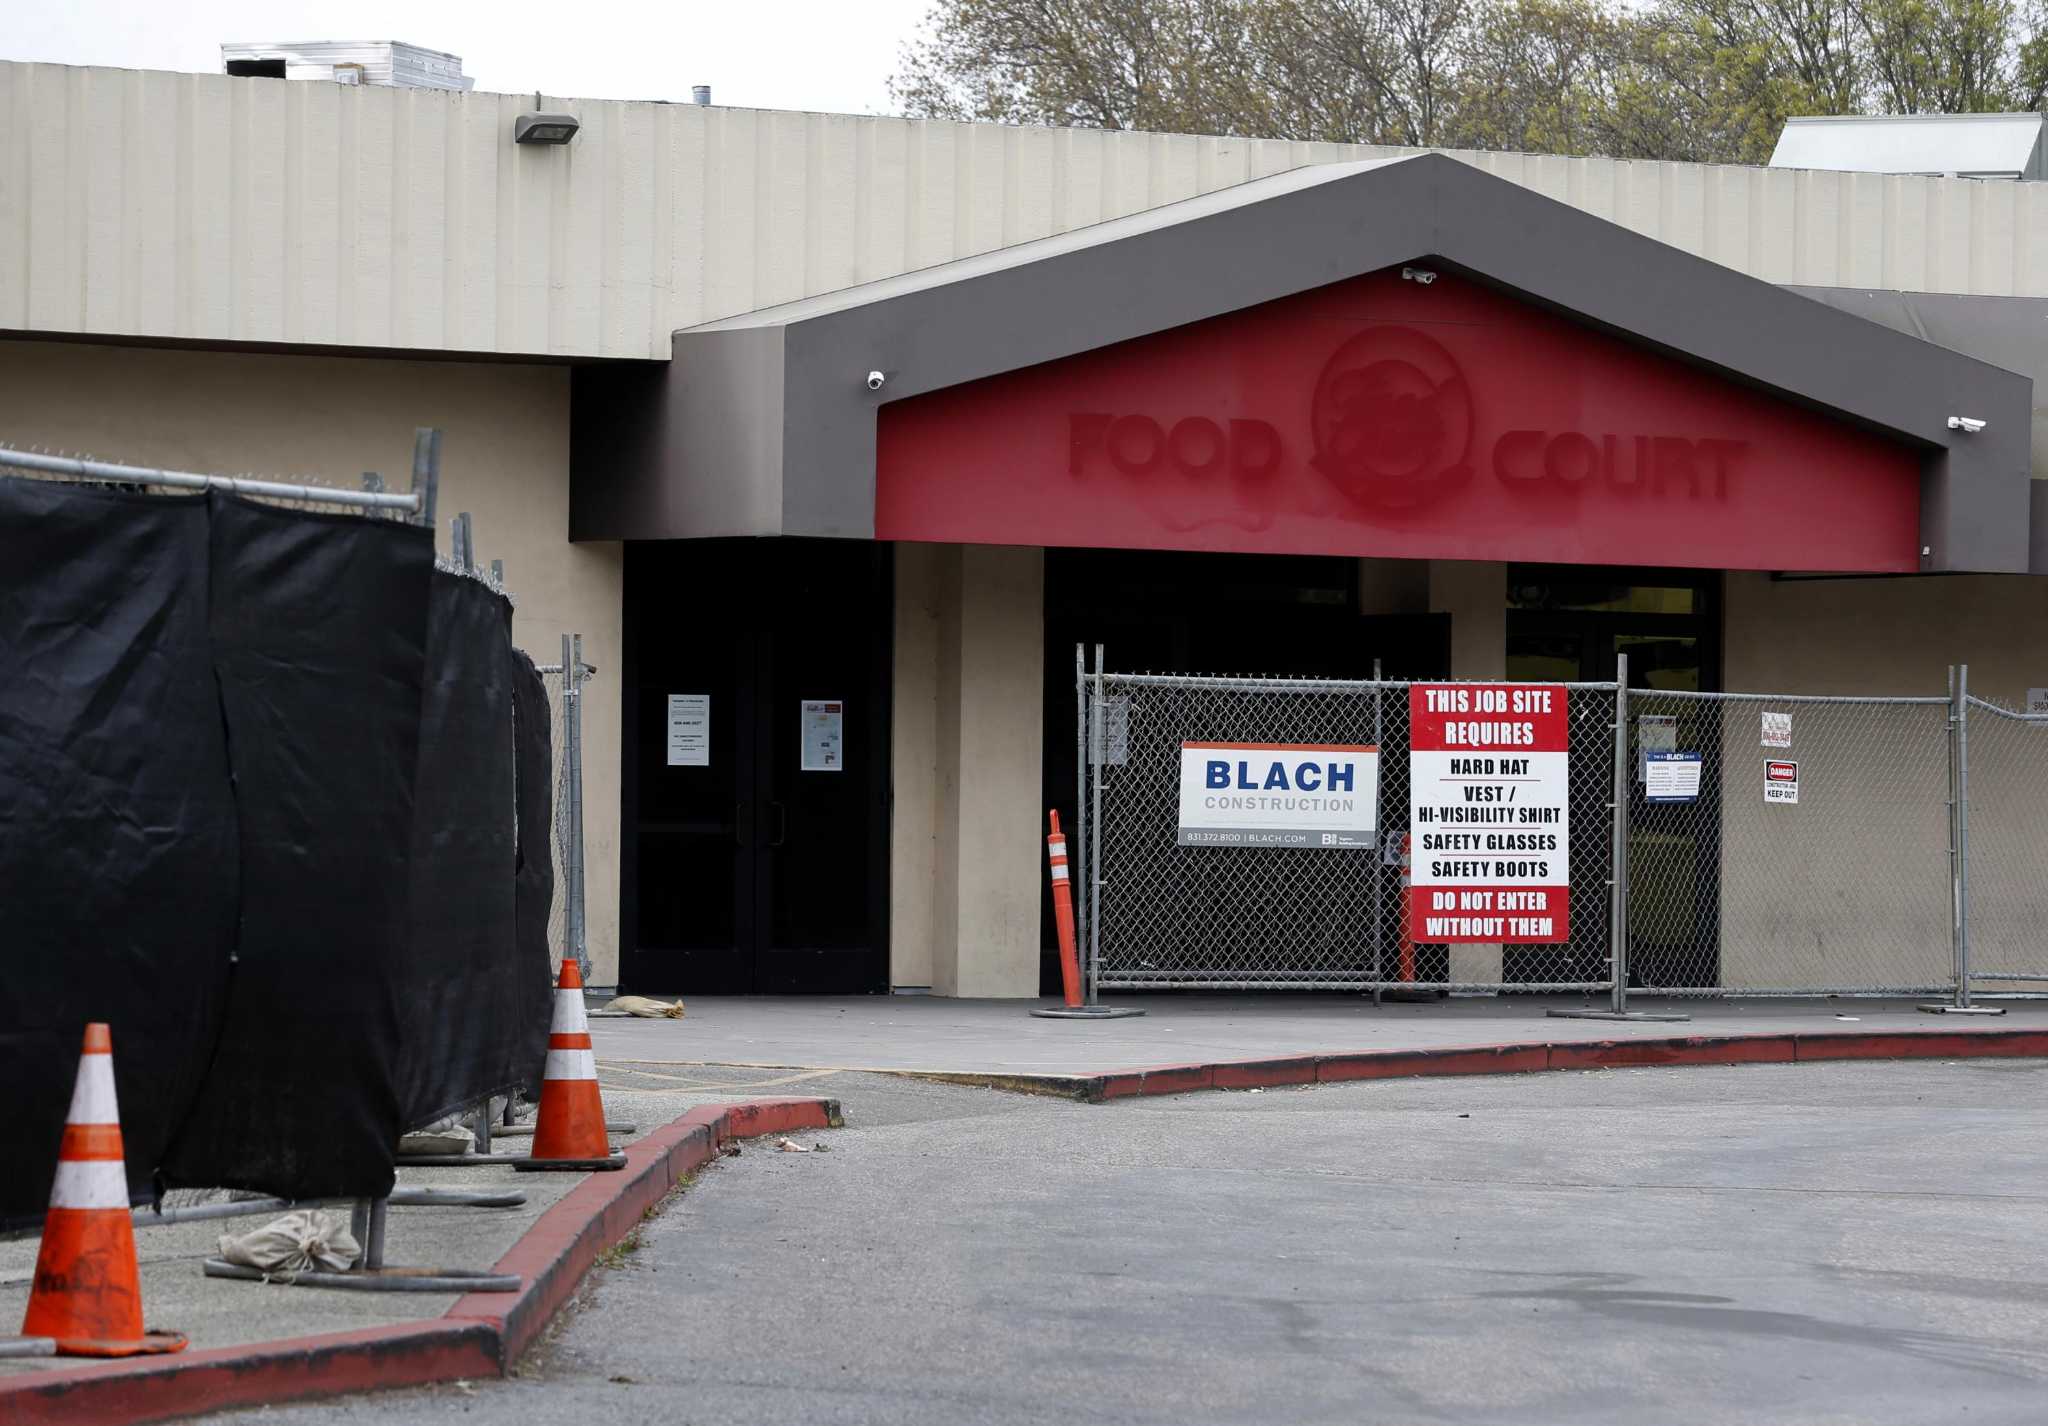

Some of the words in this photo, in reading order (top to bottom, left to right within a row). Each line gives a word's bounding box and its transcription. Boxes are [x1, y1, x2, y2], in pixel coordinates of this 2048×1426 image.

[1067, 412, 1283, 482] FOOD
[1492, 430, 1749, 505] COURT
[1425, 689, 1469, 713] THIS
[1474, 690, 1507, 713] JOB
[1513, 690, 1552, 714] SITE
[1445, 721, 1534, 747] REQUIRES
[1450, 758, 1495, 775] HARD
[1499, 759, 1529, 775] HAT
[1770, 767, 1793, 777] DANGER
[1205, 760, 1354, 792] BLACH
[1463, 786, 1503, 802] VEST
[1767, 789, 1783, 798] KEEP
[1784, 790, 1796, 799] OUT
[1204, 796, 1354, 812] CONSTRUCTION
[1418, 807, 1515, 823] HI-VISIBILITY
[1519, 807, 1561, 823] SHIRT
[1187, 833, 1241, 842] 831.372.8100
[1248, 833, 1306, 844] BLACH.COM
[1423, 834, 1482, 850] SAFETY
[1486, 834, 1557, 851] GLASSES
[1431, 861, 1490, 877] SAFETY
[1495, 861, 1548, 878] BOOTS
[1432, 891, 1456, 910] DO
[1460, 891, 1494, 911] NOT
[1497, 891, 1547, 911] ENTER
[1425, 917, 1505, 936] WITHOUT
[1508, 917, 1553, 936] THEM
